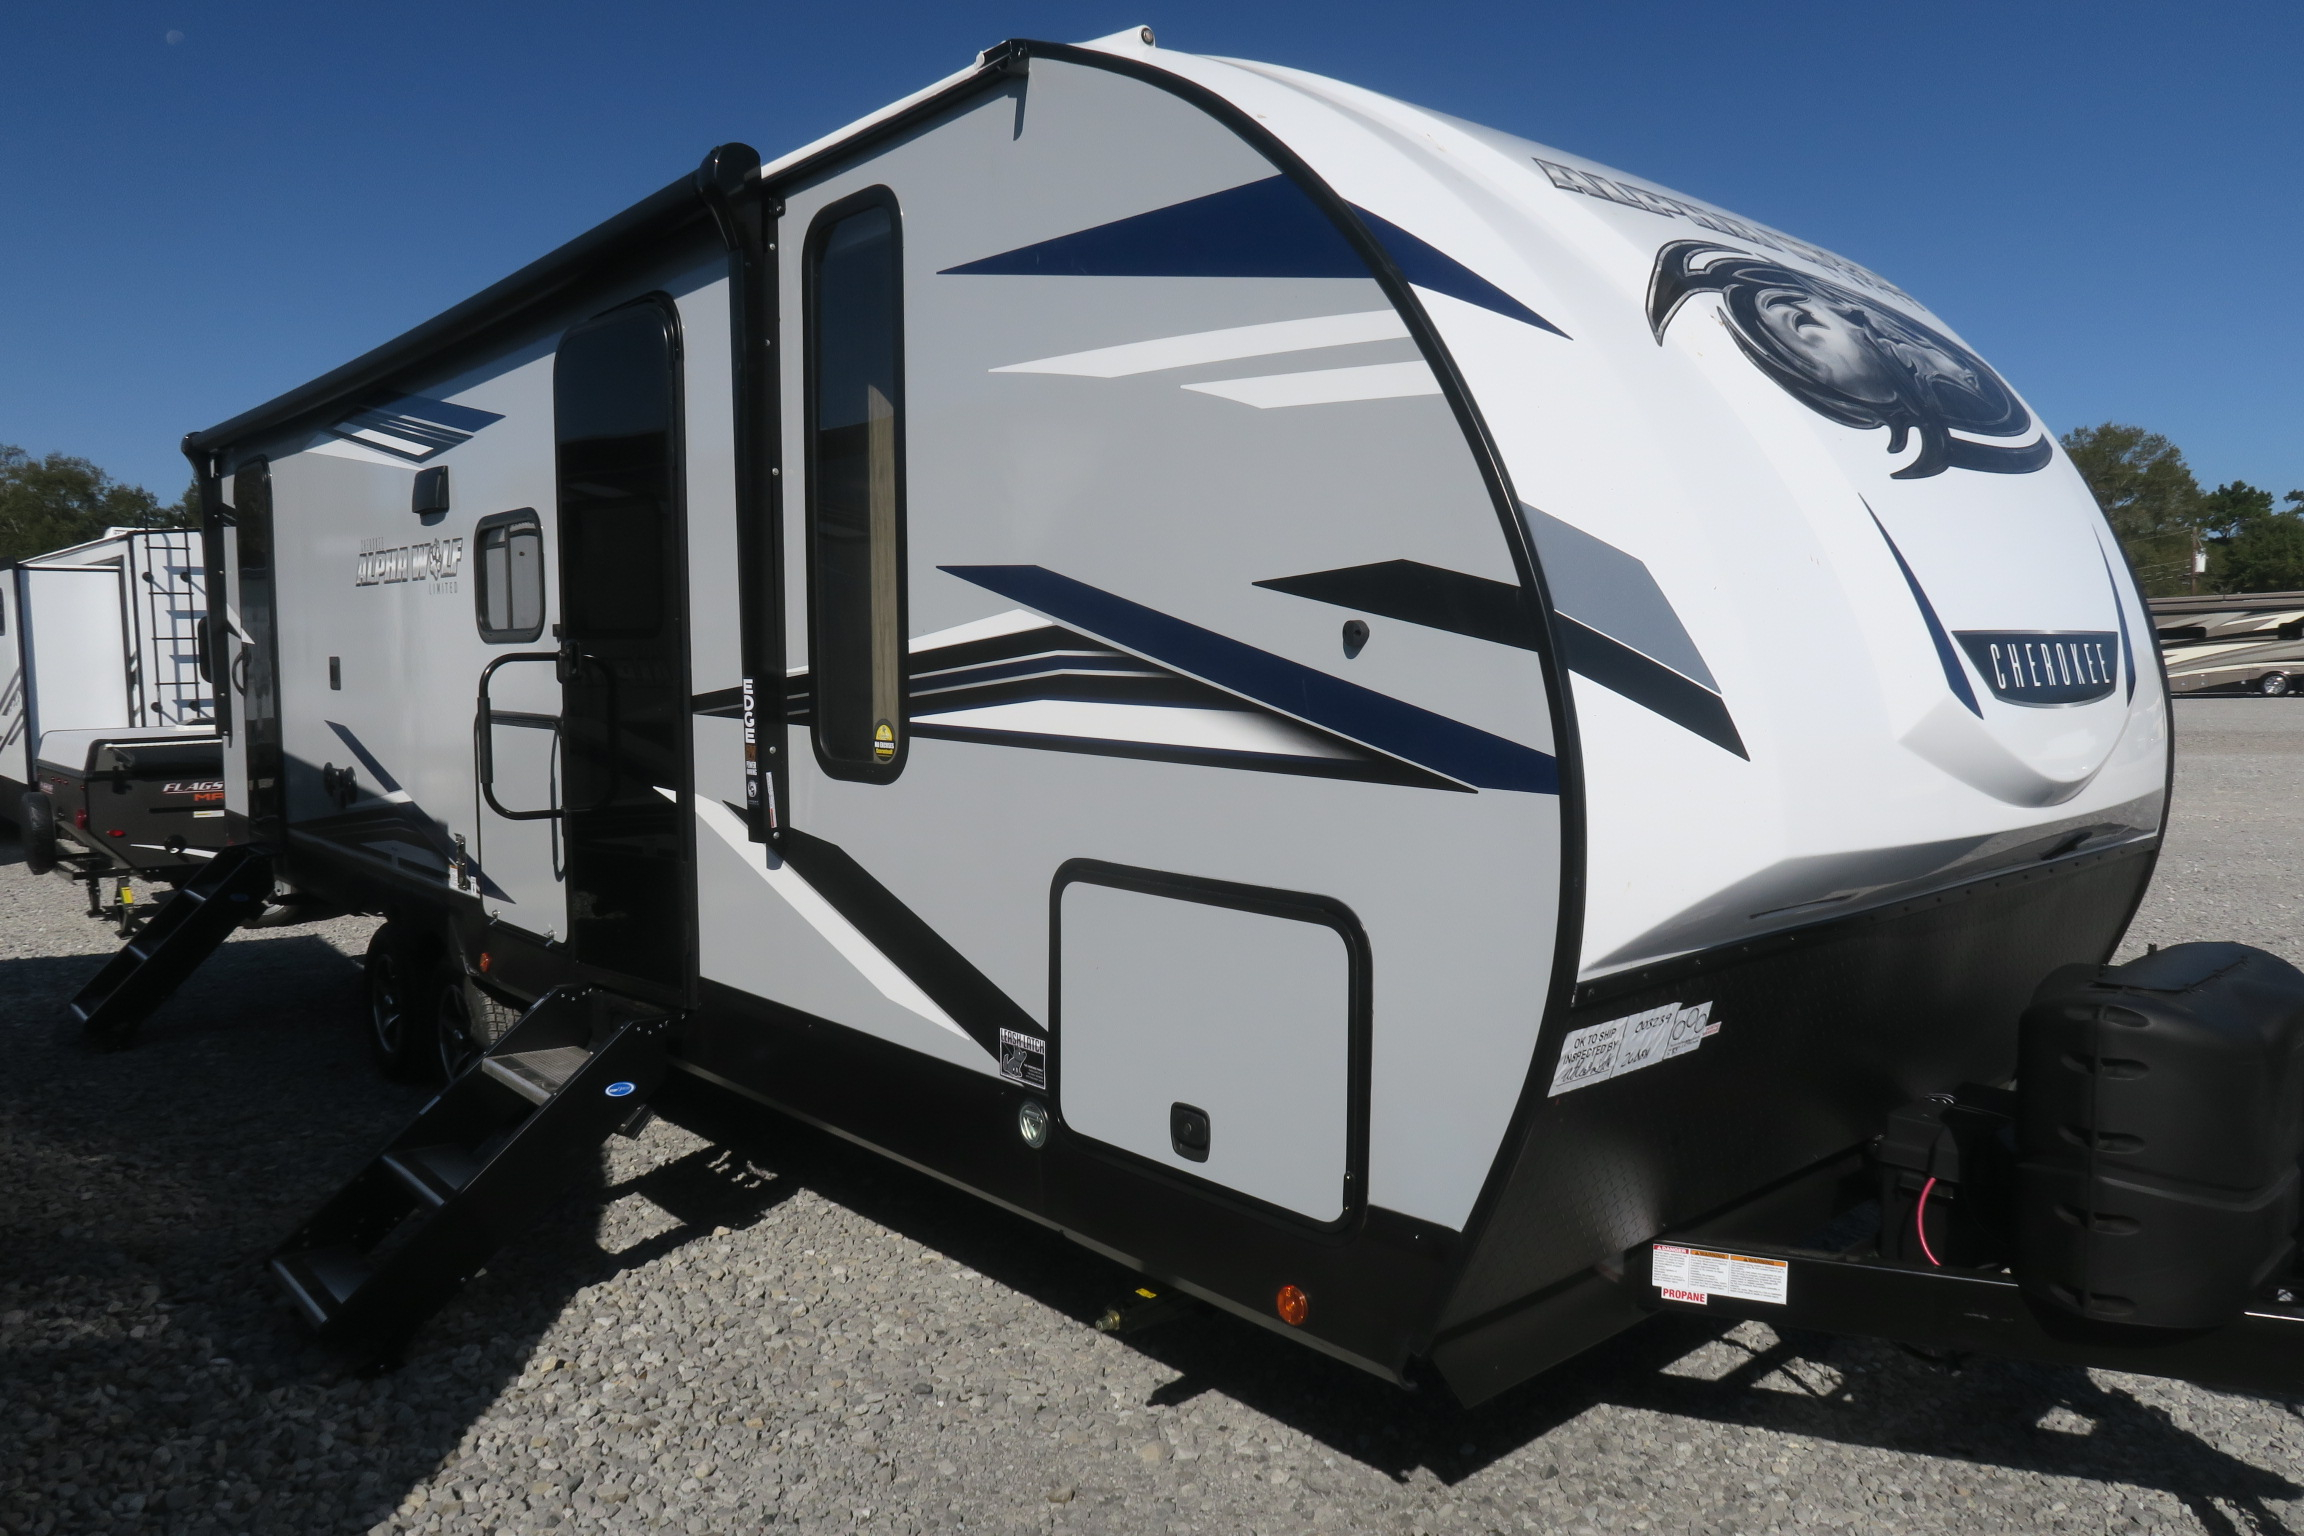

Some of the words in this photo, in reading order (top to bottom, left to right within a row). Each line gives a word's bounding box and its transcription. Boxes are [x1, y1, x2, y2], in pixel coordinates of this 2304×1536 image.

[356, 547, 409, 587] ALPHA
[428, 581, 458, 595] LIMITED
[1990, 643, 2110, 690] CHEROKEE
[743, 679, 755, 743] EDGE
[1574, 1037, 1586, 1049] OK
[1587, 1033, 1597, 1044] TO
[1599, 1027, 1617, 1042] SHIP
[1563, 1044, 1607, 1065] INSPECTED
[1606, 1040, 1619, 1053] BY
[1661, 1245, 1687, 1254] DANGER
[1663, 1289, 1705, 1302] PROPANE
